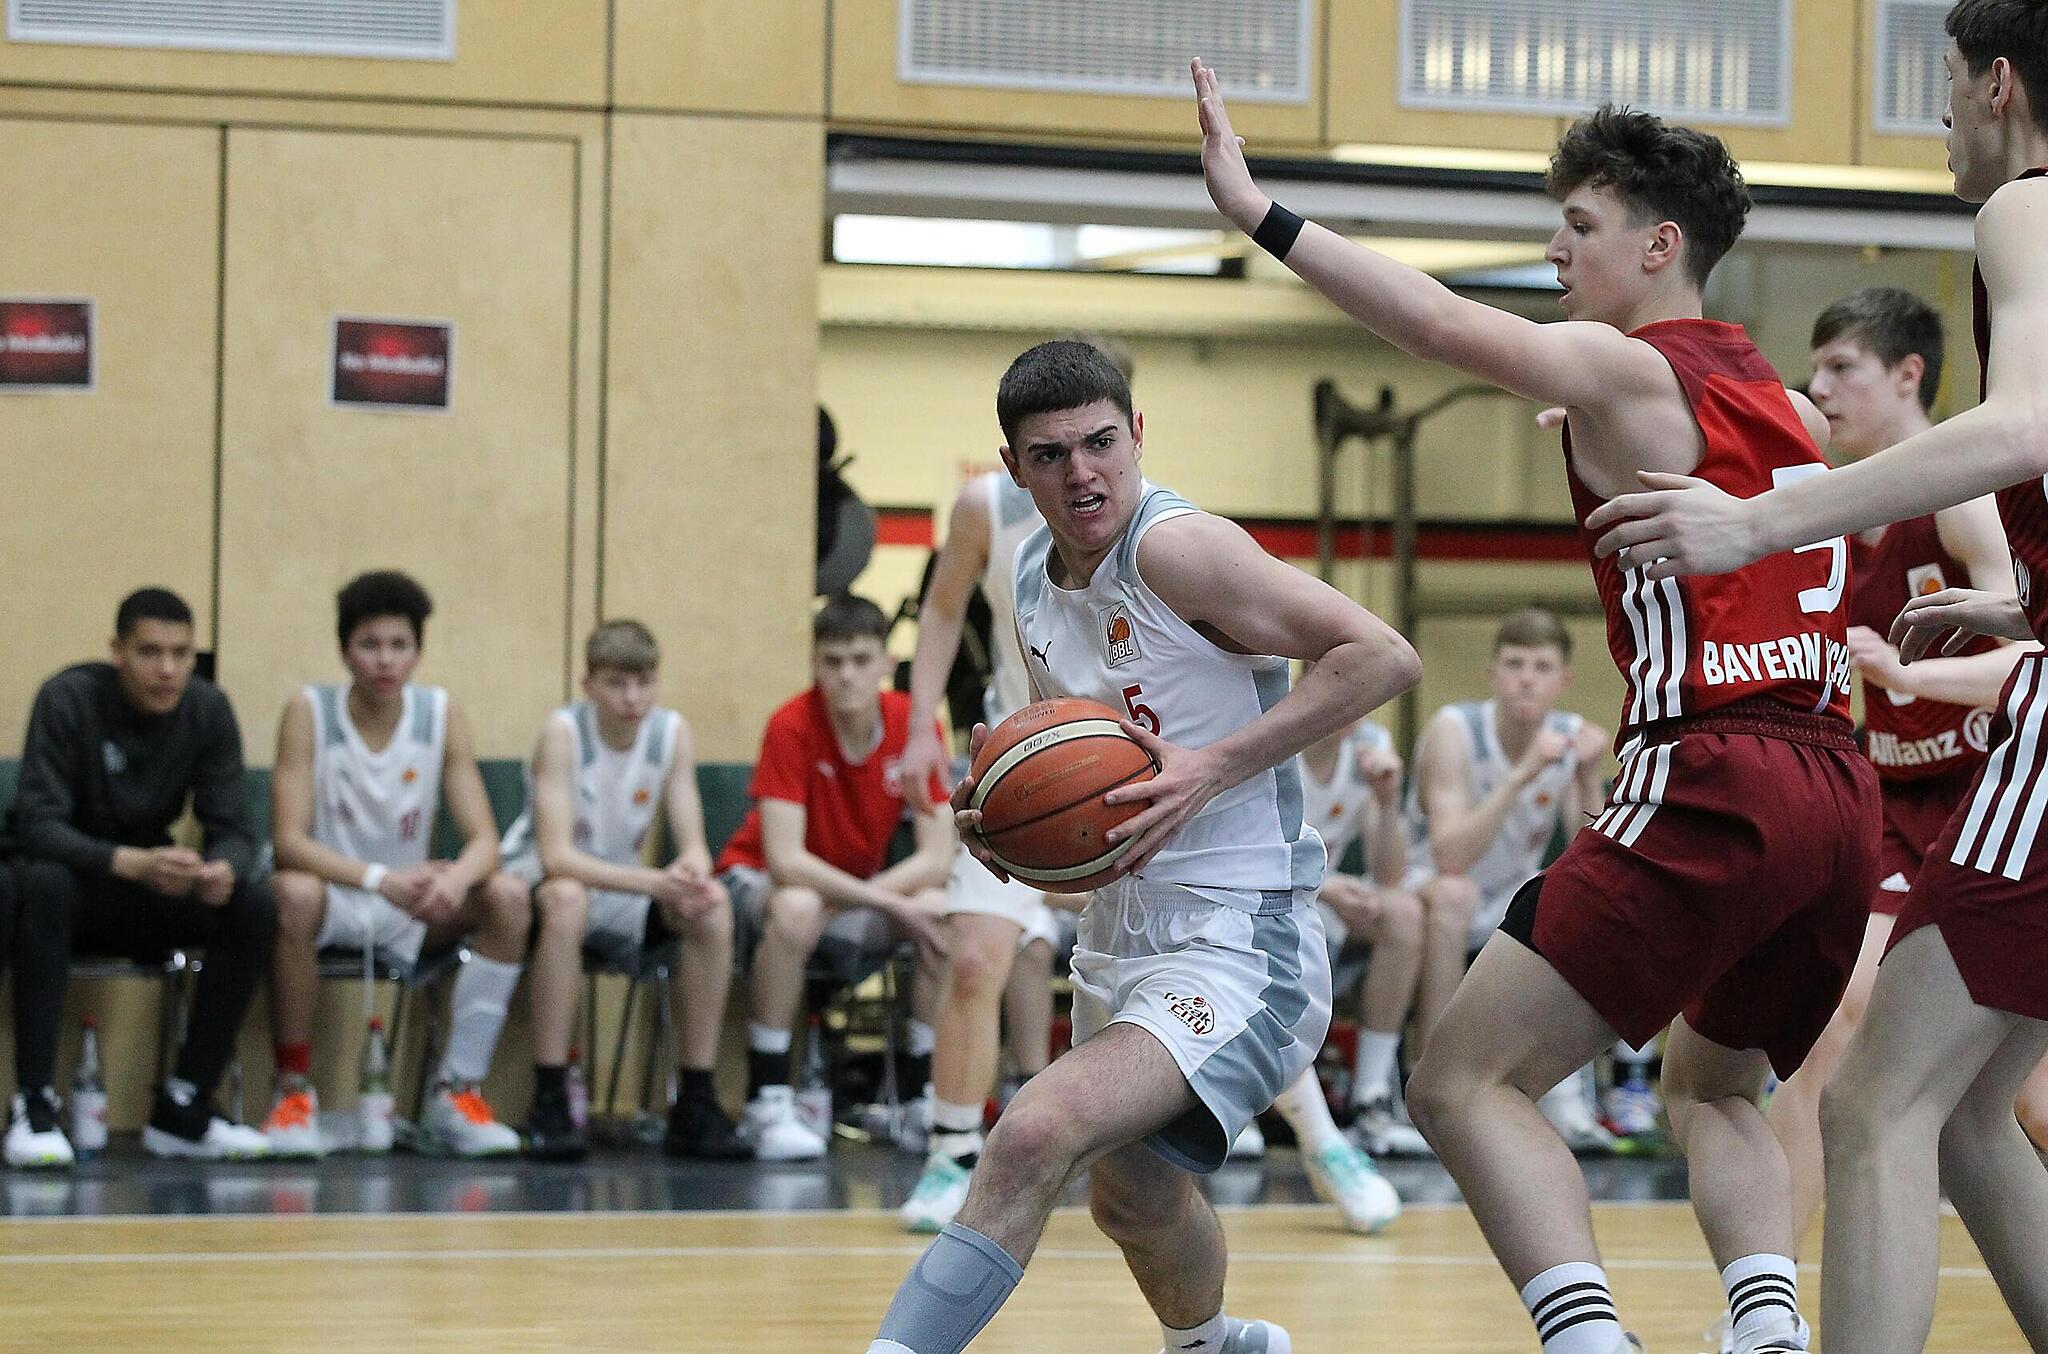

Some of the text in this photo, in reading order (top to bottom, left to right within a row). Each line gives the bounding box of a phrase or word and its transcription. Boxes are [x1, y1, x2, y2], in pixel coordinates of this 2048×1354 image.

[1702, 632, 1821, 686] BAYERN
[1121, 682, 1161, 737] 5
[1868, 729, 1963, 767] Allianz
